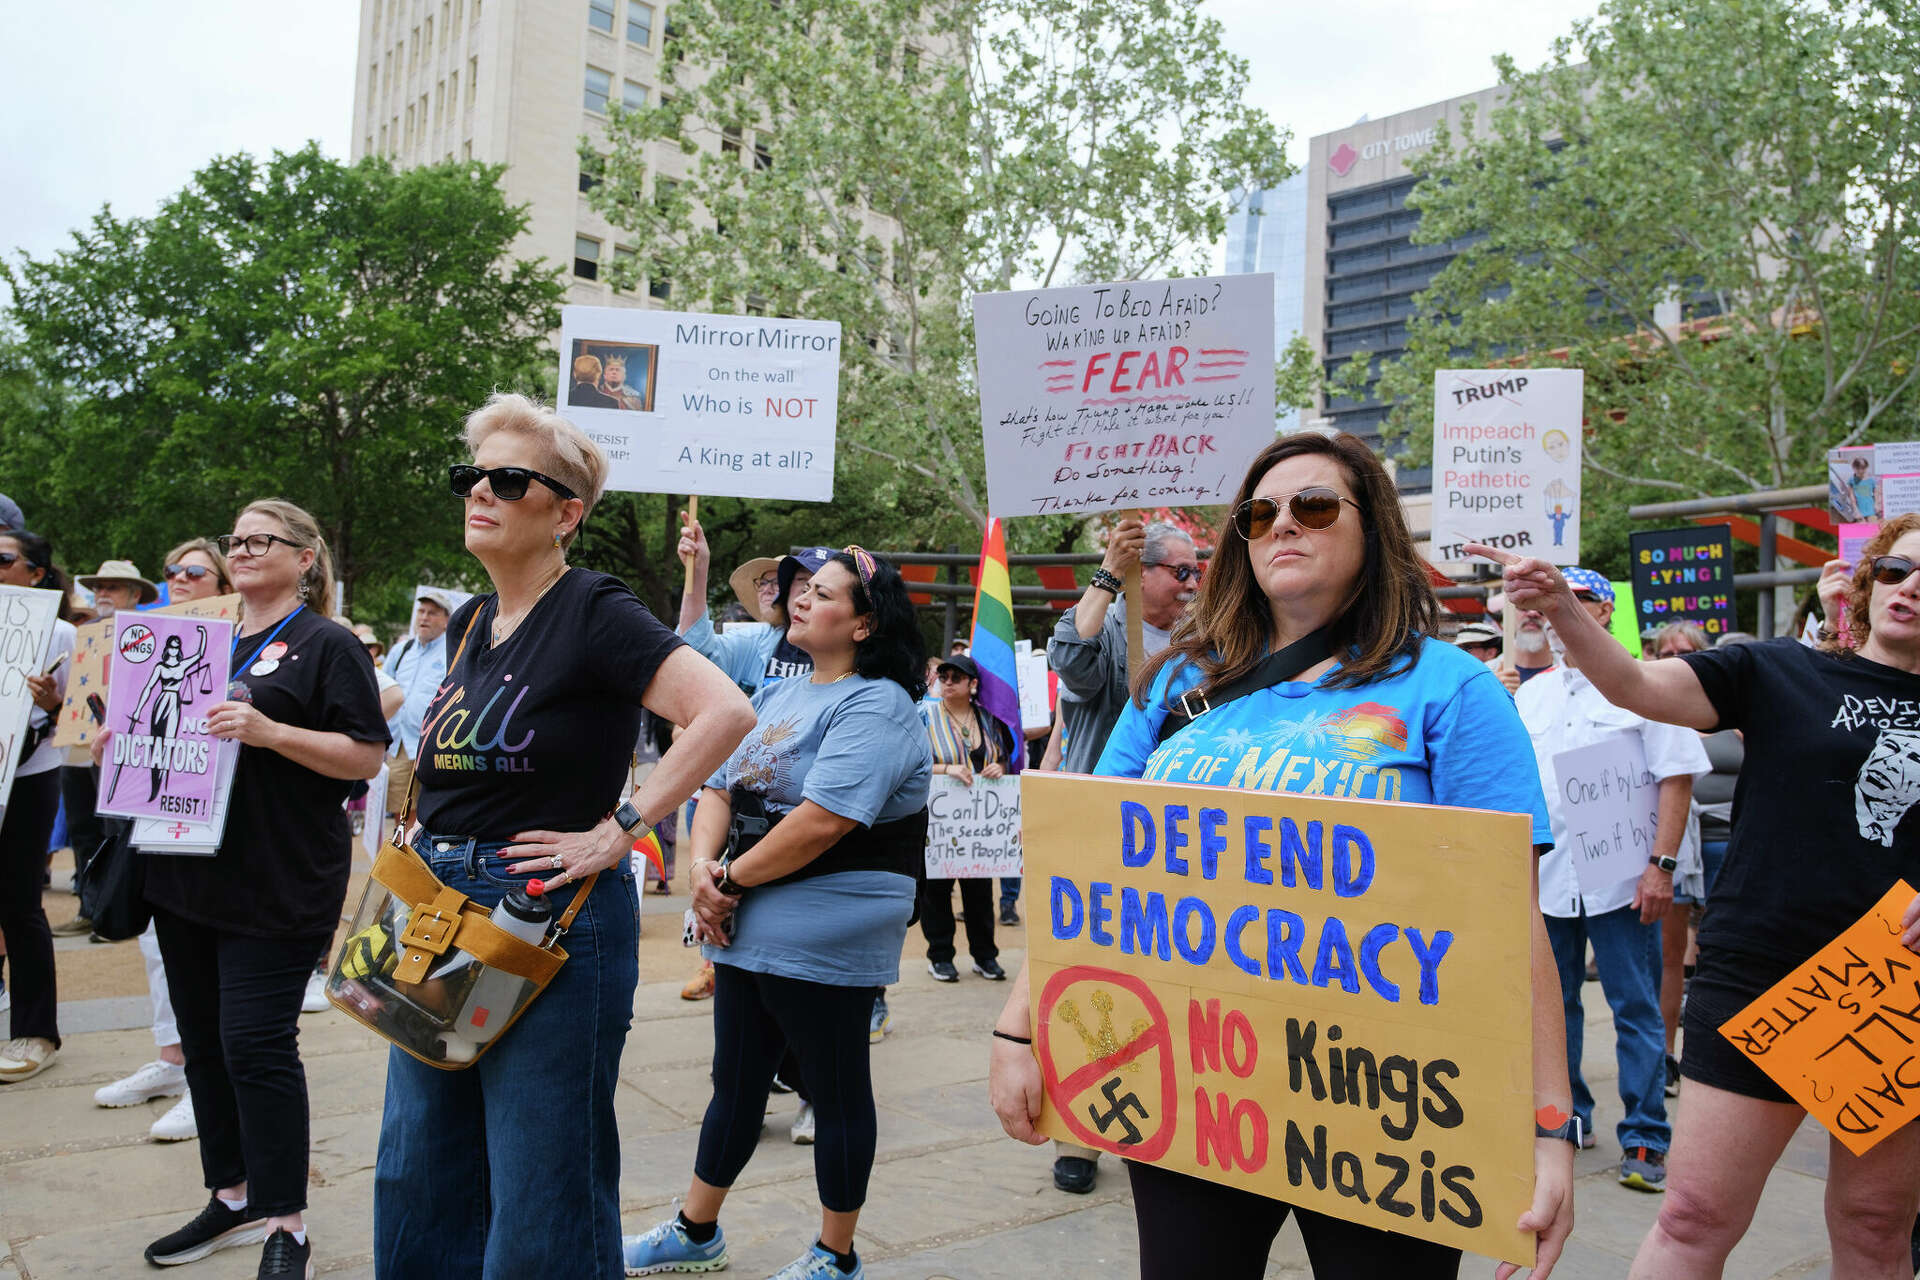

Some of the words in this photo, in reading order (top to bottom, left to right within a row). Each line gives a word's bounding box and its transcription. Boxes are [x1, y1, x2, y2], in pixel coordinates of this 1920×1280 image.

[1362, 138, 1392, 160] CITY
[1394, 128, 1438, 152] TOWE
[1026, 297, 1080, 326] GOING
[1119, 289, 1151, 318] BED
[676, 324, 754, 347] Mirror
[758, 327, 837, 351] Mirror
[1046, 328, 1105, 352] WAKING
[708, 367, 730, 382] On
[735, 368, 760, 383] the
[764, 369, 795, 383] wall
[1082, 346, 1189, 393] FEAR
[1452, 377, 1528, 405] TRUMP
[682, 393, 731, 414] Who
[738, 397, 753, 415] is
[765, 398, 818, 418] NOT
[1077, 407, 1119, 421] Trump
[1443, 423, 1535, 443] Impeach
[678, 446, 693, 464] A
[700, 448, 744, 471] King
[752, 451, 772, 468] at
[778, 450, 813, 469] all?
[1453, 446, 1522, 464] Putin's
[1054, 466, 1080, 484] Do
[1444, 471, 1531, 488] Pathetic
[1449, 491, 1524, 512] Puppet
[1439, 531, 1533, 561] TRITOR
[1640, 549, 1665, 564] SO
[1669, 544, 1723, 562] MUCH
[1651, 566, 1721, 585] LYING!
[1642, 599, 1668, 614] SO
[1671, 594, 1727, 612] MUCH
[0, 628, 43, 665] ION
[131, 629, 145, 640] NO
[124, 641, 152, 654] KINGS
[1843, 694, 1920, 716] DEVI
[181, 717, 209, 735] NO
[112, 733, 209, 775] DICTATORS
[434, 753, 488, 771] MEANS
[495, 757, 535, 773] ALL
[1188, 756, 1229, 783] OF
[1228, 747, 1401, 801] MEXICO
[1566, 777, 1599, 805] One
[1615, 766, 1631, 802] by
[1120, 800, 1376, 898] DEFEND
[1576, 832, 1609, 861] Two
[1629, 818, 1650, 854] by
[1050, 876, 1455, 1006] DEMOCRACY
[1731, 946, 1869, 1056] MATTER
[1188, 998, 1258, 1078] NO
[1285, 1018, 1465, 1142] Kings
[1195, 1086, 1269, 1173] NO
[1285, 1120, 1484, 1228] Nazis
